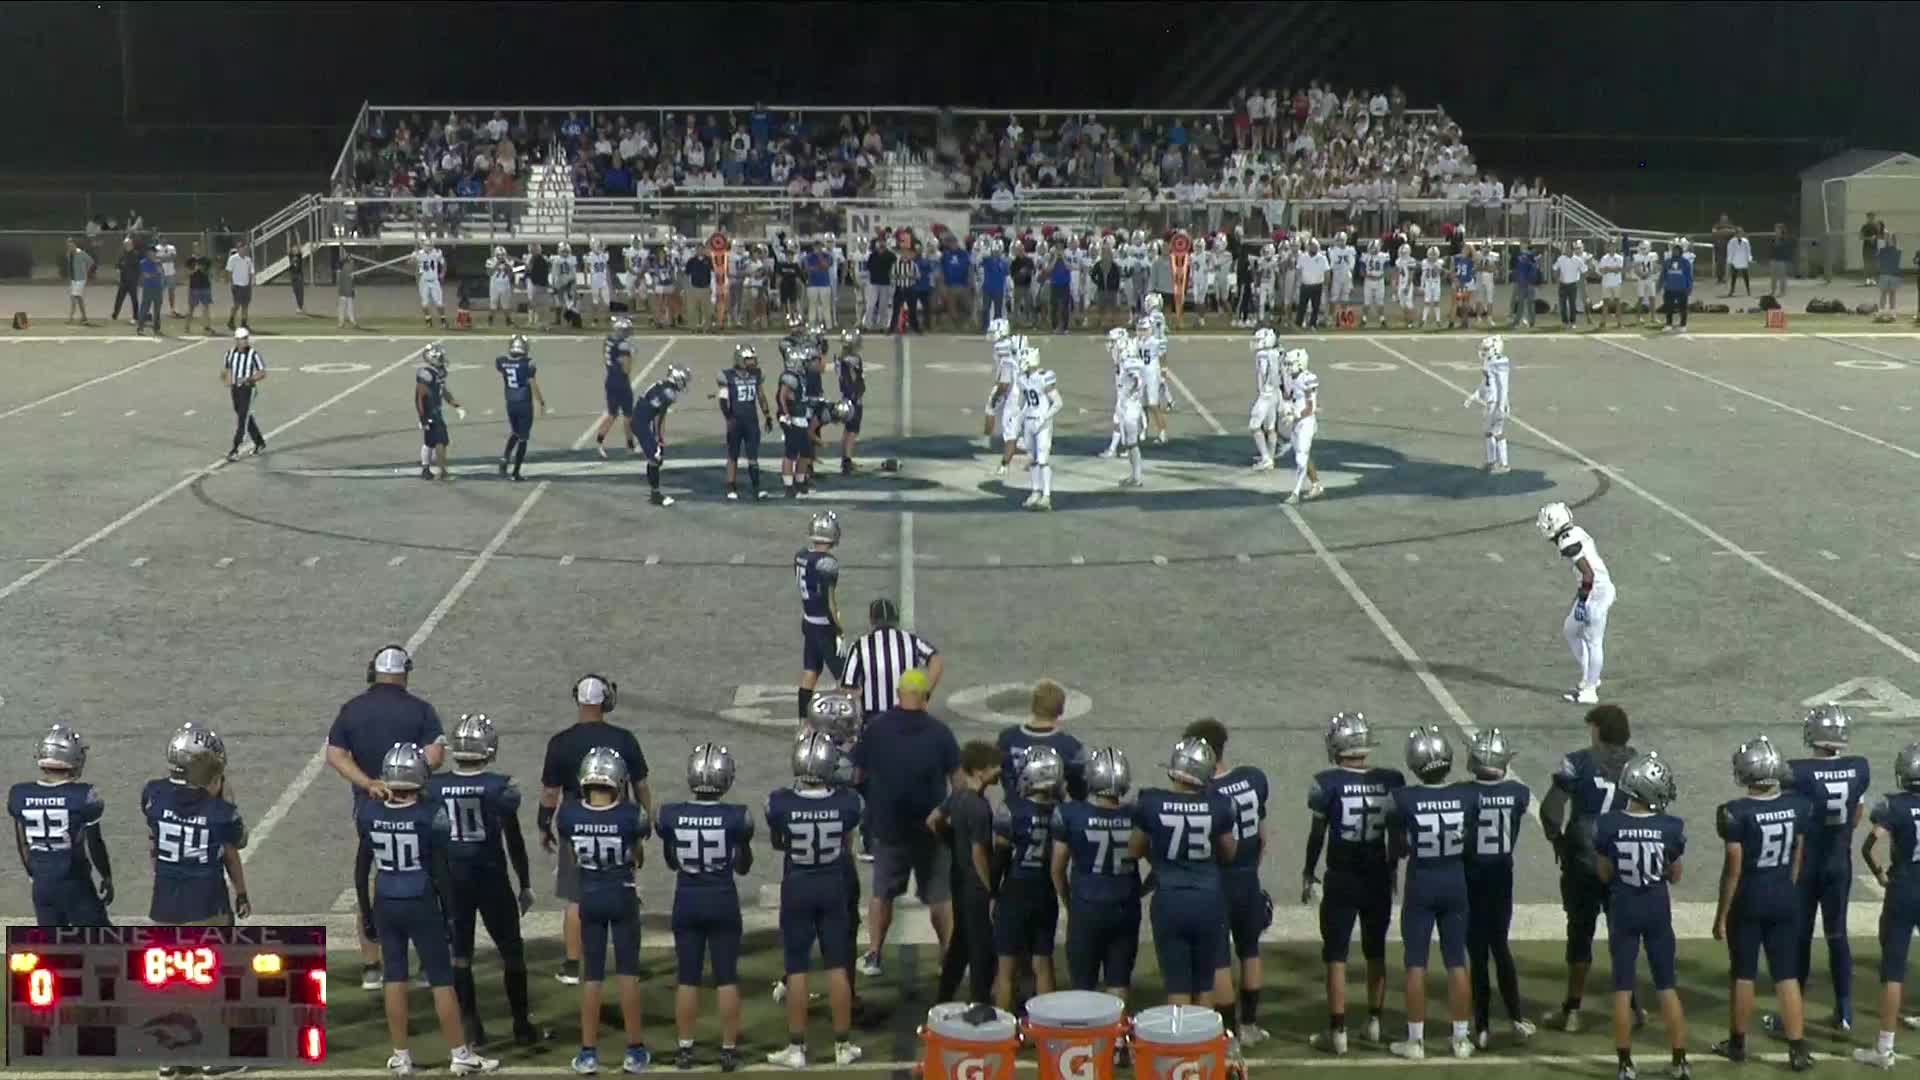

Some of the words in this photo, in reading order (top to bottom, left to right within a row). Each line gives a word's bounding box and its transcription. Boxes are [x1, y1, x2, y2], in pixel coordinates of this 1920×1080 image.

[1814, 769, 1856, 780] PRIDE
[441, 786, 485, 796] PRIDE
[1218, 779, 1250, 795] RIDE
[1344, 784, 1385, 793] PRIDE
[25, 797, 65, 806] PRIDE
[1163, 802, 1209, 812] PRIDE
[1416, 800, 1461, 810] PRIDE
[1482, 796, 1515, 806] RIDE
[1825, 782, 1848, 825] 3
[163, 809, 207, 825] PDE
[444, 798, 487, 842] 10
[678, 816, 723, 826] PRIDE
[791, 810, 839, 820] PRIDE
[1231, 789, 1260, 841] 3
[1755, 809, 1796, 823] PRIDE
[21, 809, 72, 852] 23
[373, 820, 414, 831] PRIDE
[574, 824, 618, 834] PRIDE
[1477, 808, 1512, 854] 21
[158, 820, 209, 864] 54
[1159, 814, 1212, 861] 73
[1414, 811, 1465, 858] 32
[1618, 829, 1662, 839] PRIDE
[787, 821, 843, 865] 35
[1757, 821, 1794, 868] 61
[369, 832, 422, 871] 20
[674, 829, 727, 874] 22
[1614, 841, 1665, 887] 30
[1059, 1045, 1094, 1080] G
